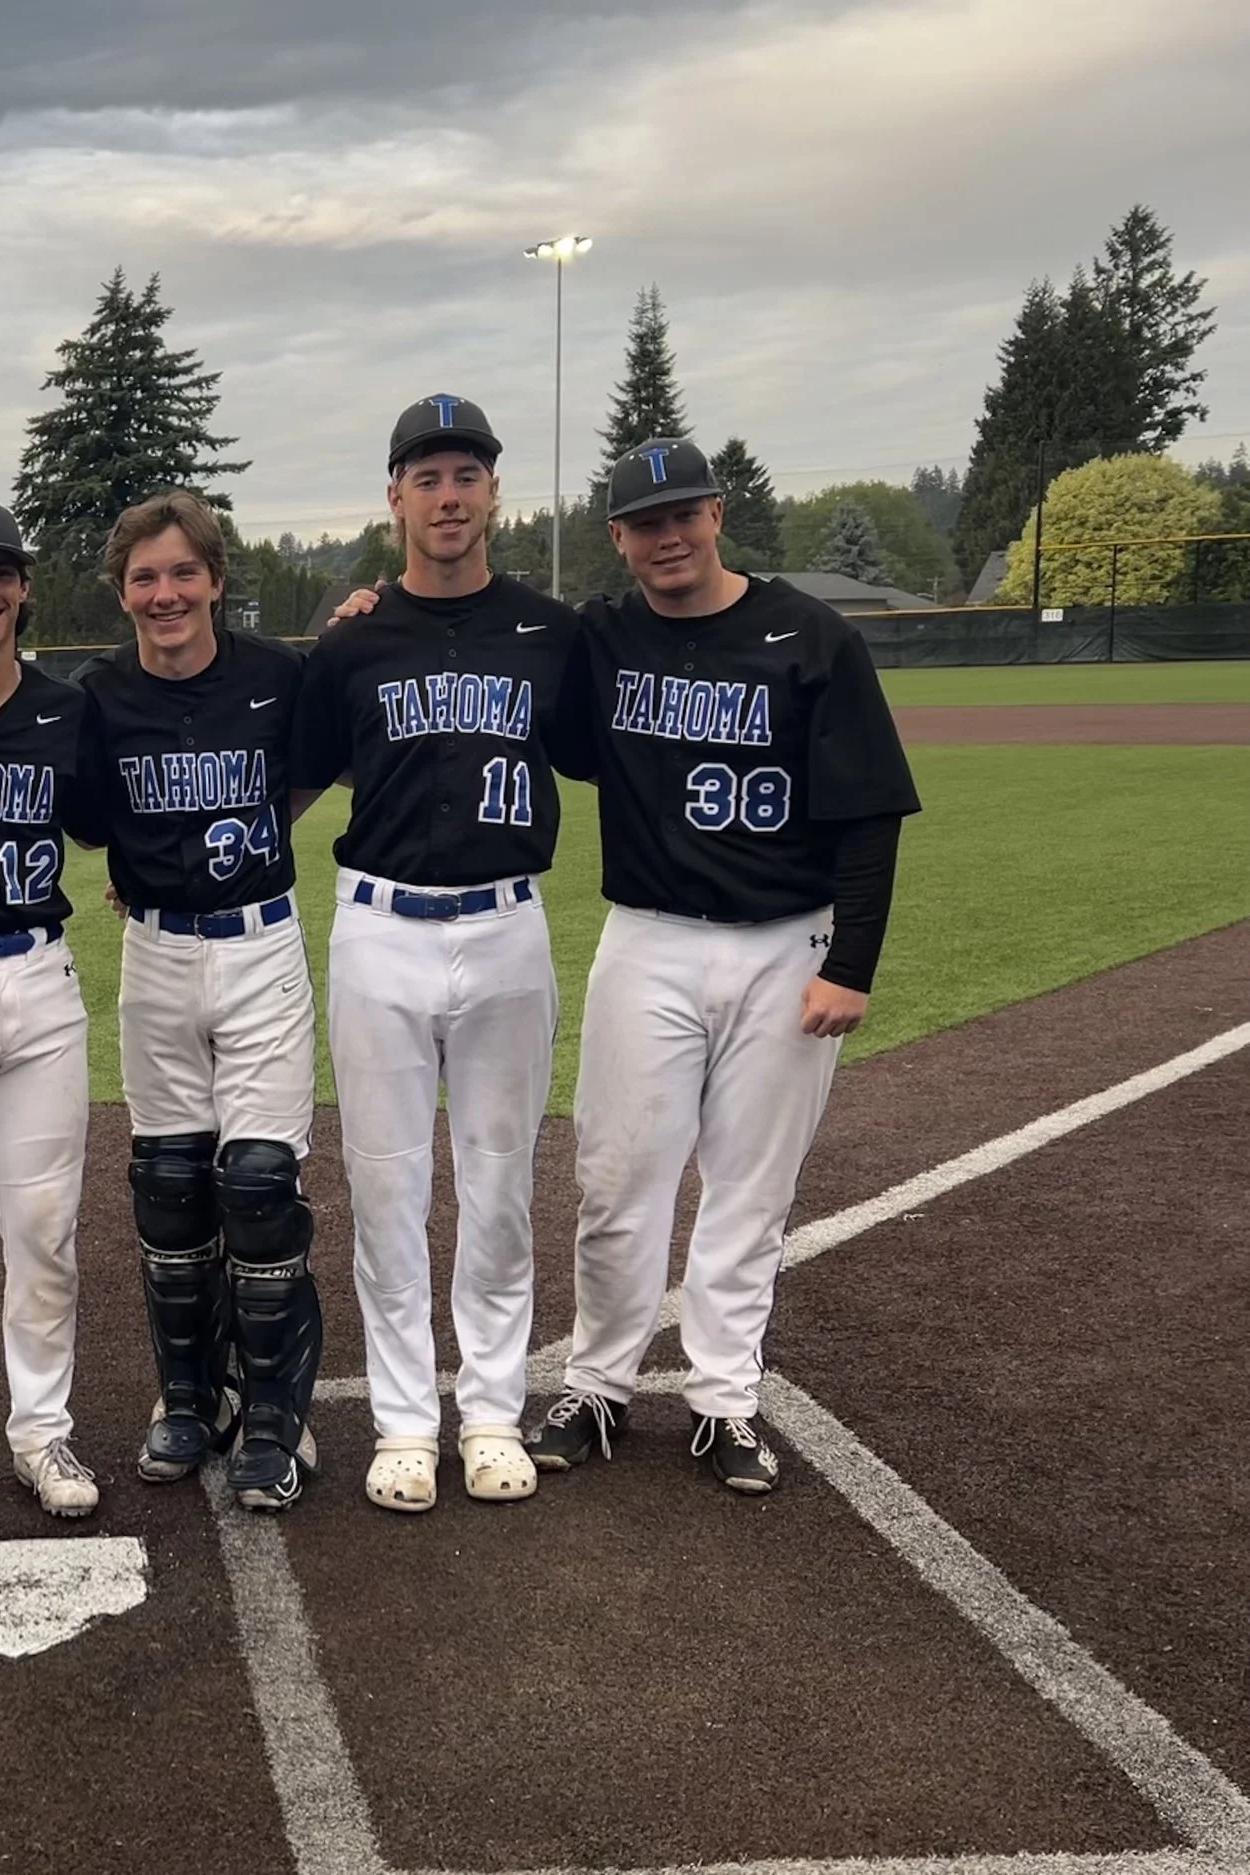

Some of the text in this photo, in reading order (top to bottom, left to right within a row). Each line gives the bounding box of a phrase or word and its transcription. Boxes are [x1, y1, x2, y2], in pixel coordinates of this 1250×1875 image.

[428, 396, 459, 428] T
[638, 447, 669, 485] T
[377, 671, 533, 742] TAHOMA
[611, 669, 772, 746] TAHOMA
[118, 749, 267, 813] TAHOMA
[478, 756, 532, 826] 11
[685, 762, 792, 832] 38
[204, 803, 280, 881] 34
